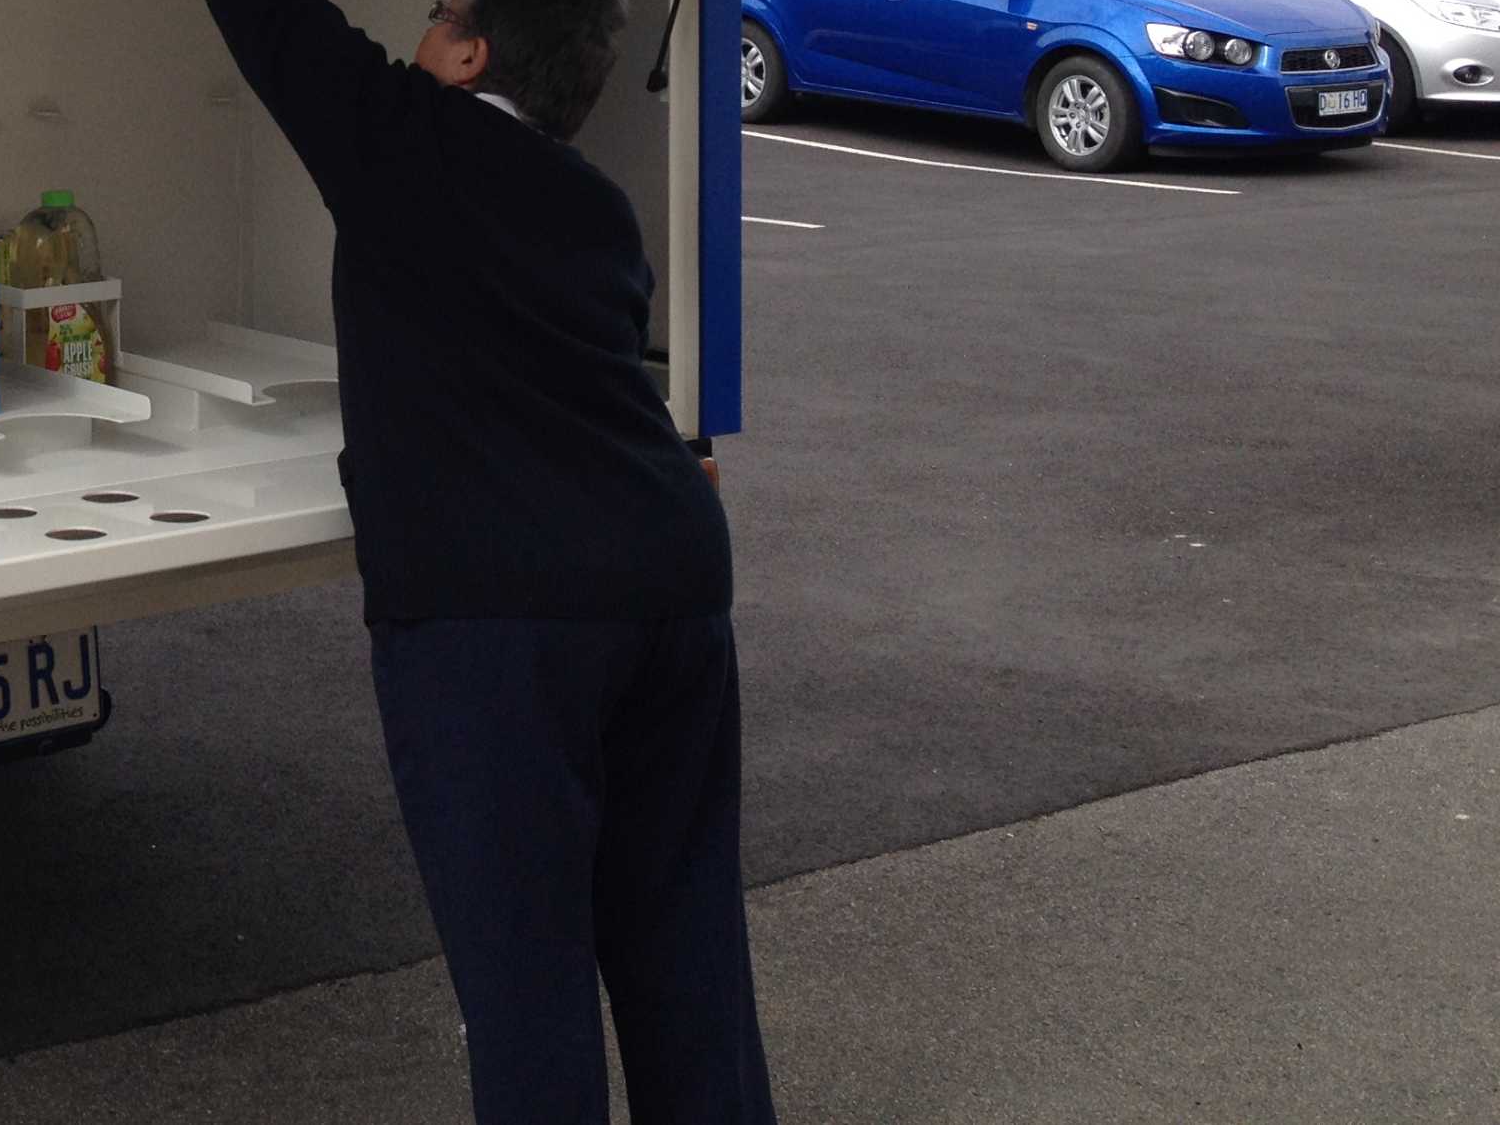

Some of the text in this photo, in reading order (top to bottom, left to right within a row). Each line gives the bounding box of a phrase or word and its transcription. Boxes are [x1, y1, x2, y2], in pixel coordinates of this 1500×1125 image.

[63, 341, 92, 364] APPLE
[27, 634, 92, 709] RJ
[20, 706, 84, 731] possibilities
